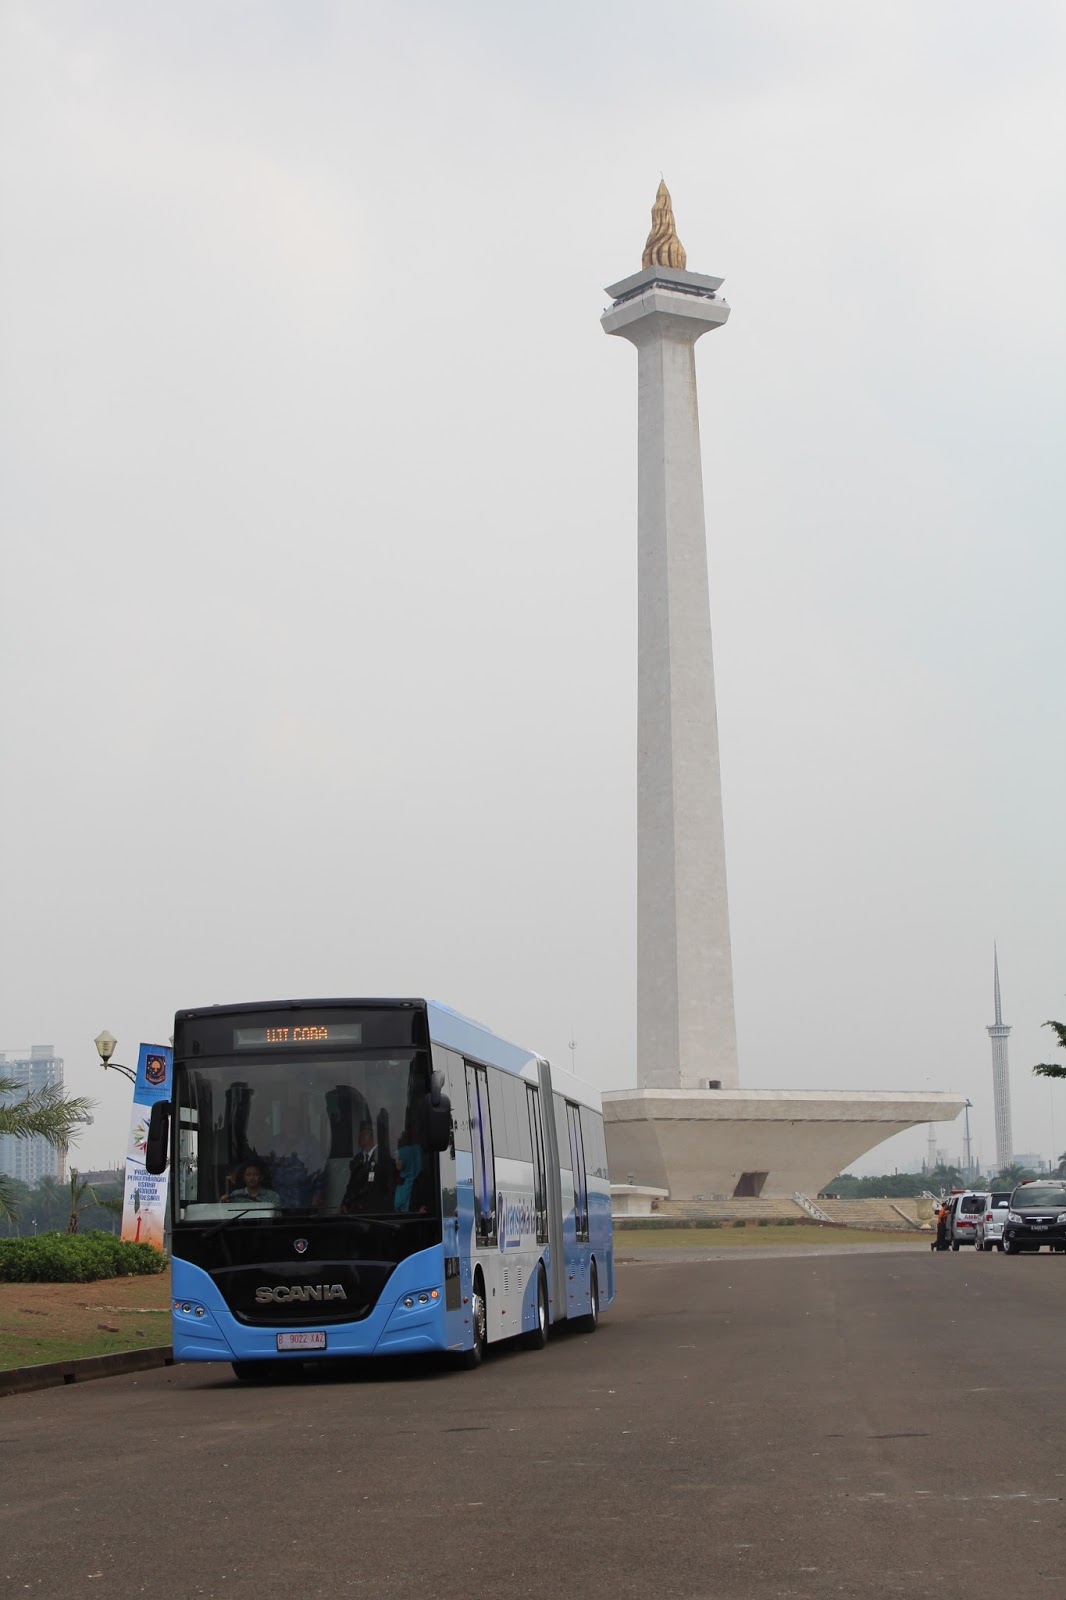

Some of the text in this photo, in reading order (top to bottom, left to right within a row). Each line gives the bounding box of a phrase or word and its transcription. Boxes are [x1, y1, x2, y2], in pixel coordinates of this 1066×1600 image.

[255, 1284, 348, 1304] SCANIA
[278, 1335, 284, 1345] B
[289, 1334, 308, 1344] 9022
